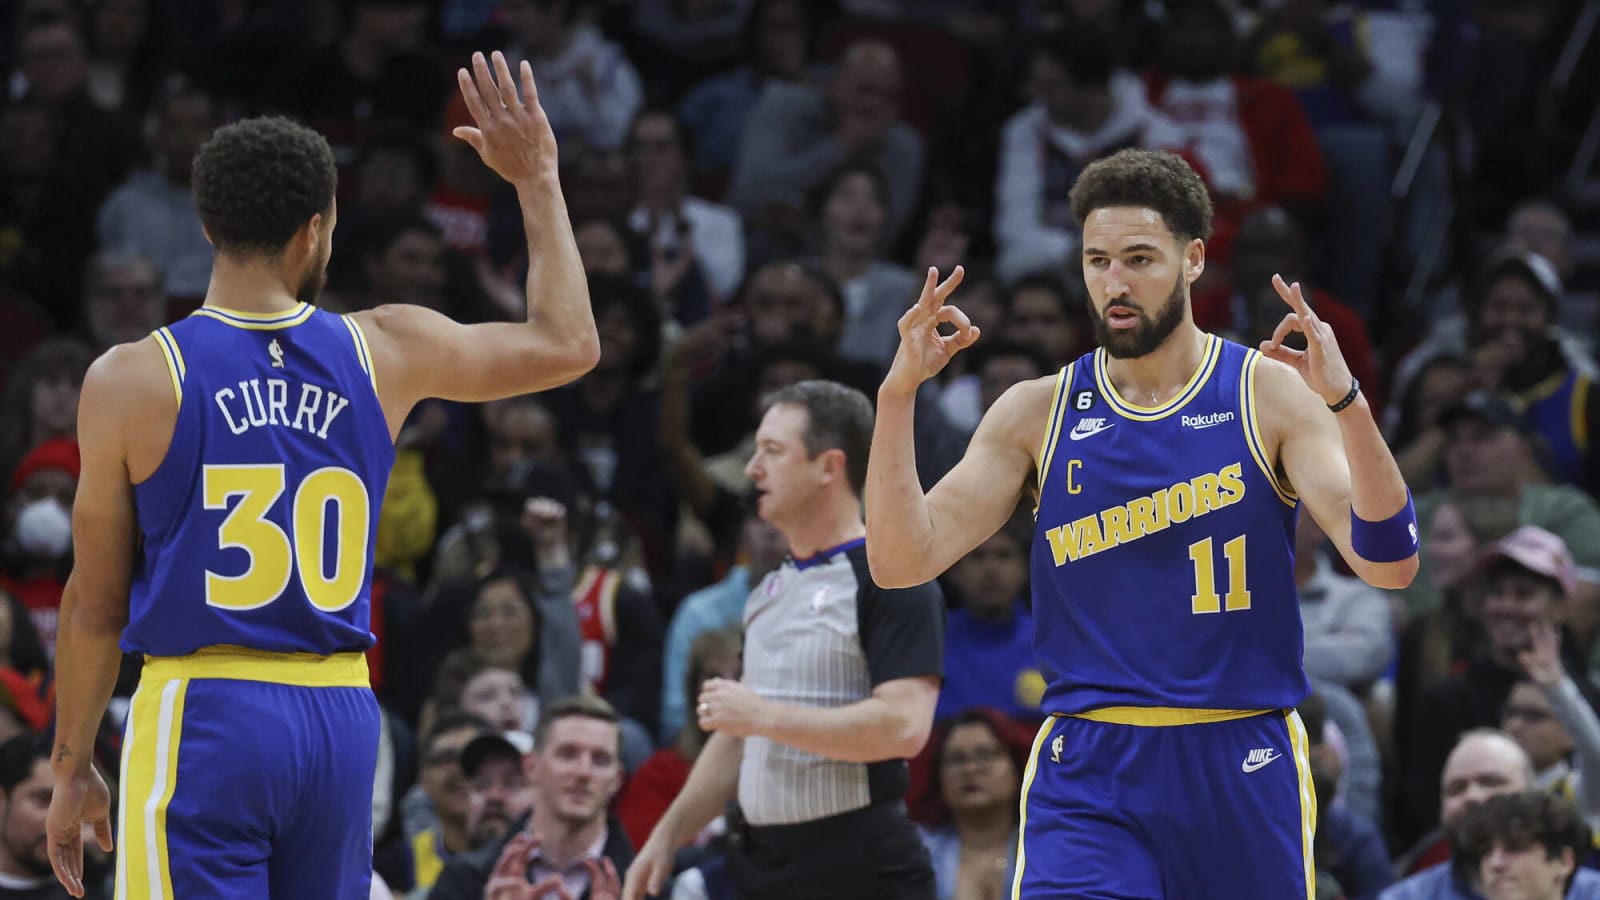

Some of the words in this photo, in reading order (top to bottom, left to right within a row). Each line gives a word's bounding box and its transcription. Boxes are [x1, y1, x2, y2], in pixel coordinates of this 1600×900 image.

[214, 378, 349, 440] CURRY
[1076, 391, 1093, 410] 6
[1077, 418, 1107, 432] NIKE
[1181, 411, 1235, 429] Rakuten
[1067, 459, 1083, 495] C
[1045, 461, 1246, 568] WARRIORS
[202, 463, 370, 613] 30
[1188, 533, 1252, 615] 11
[1247, 748, 1275, 763] NIKE
